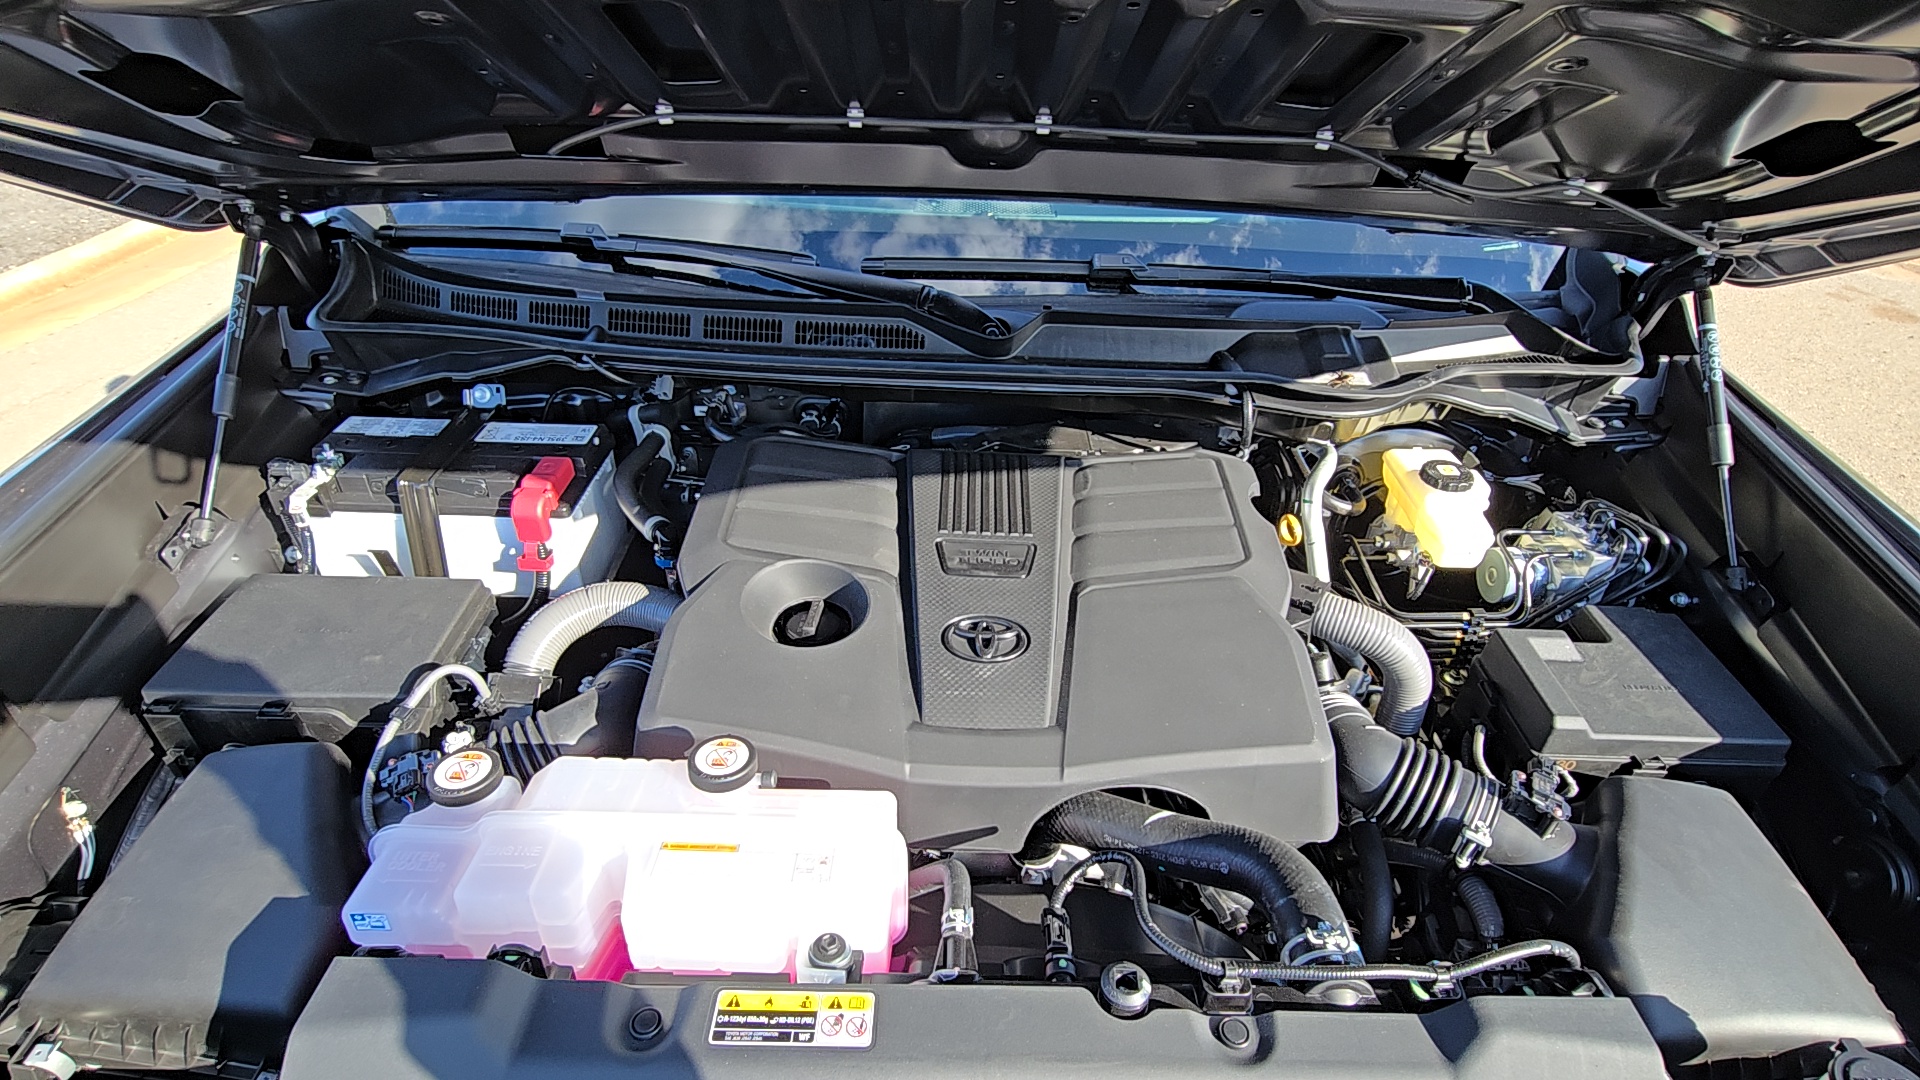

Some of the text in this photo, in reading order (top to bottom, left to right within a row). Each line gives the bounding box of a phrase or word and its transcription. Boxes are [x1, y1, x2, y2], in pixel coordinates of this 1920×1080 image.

[960, 548, 1009, 557] TWIN
[391, 850, 440, 861] INTER
[485, 846, 543, 856] ENGINE
[387, 861, 447, 872] COOLER
